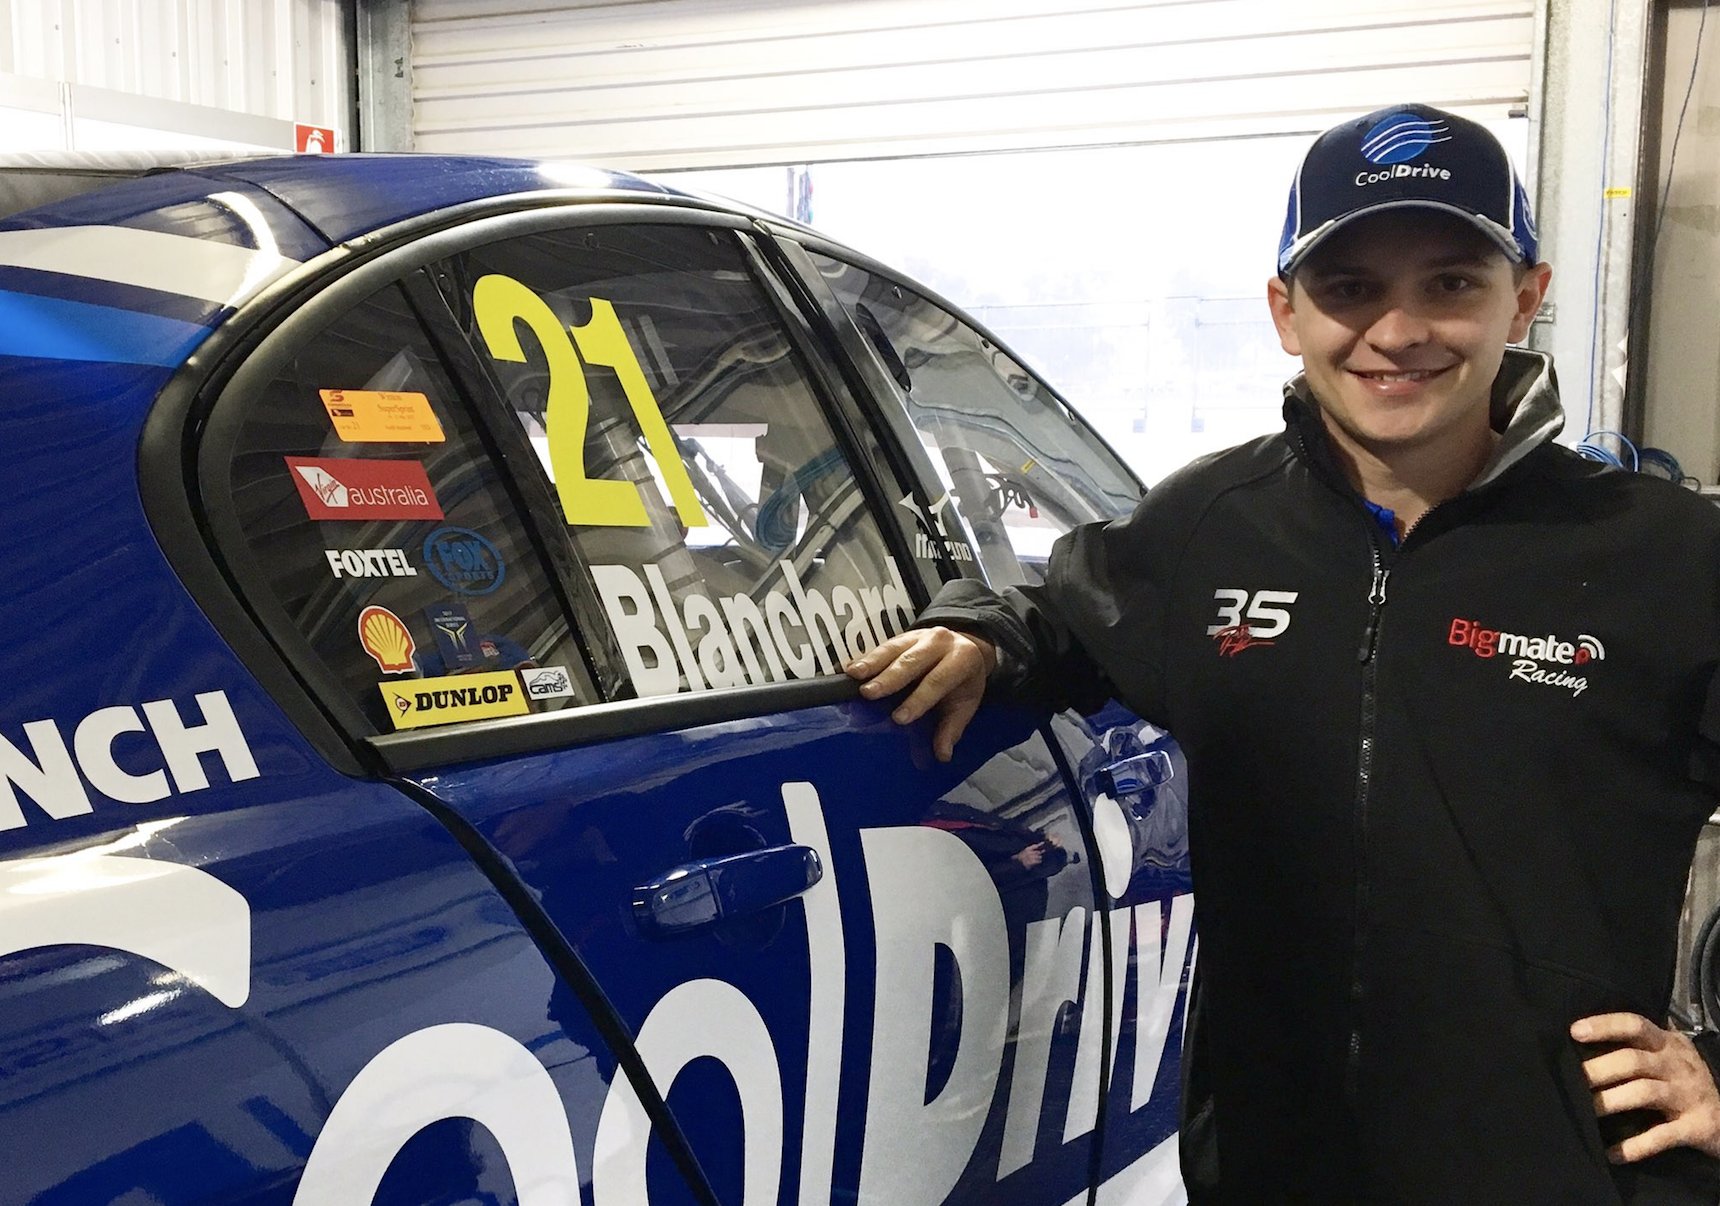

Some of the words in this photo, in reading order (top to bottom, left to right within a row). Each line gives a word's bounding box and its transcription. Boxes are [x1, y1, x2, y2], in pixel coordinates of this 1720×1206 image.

[1356, 163, 1451, 187] CoolDrive
[473, 274, 708, 527] 21
[315, 473, 340, 504] Virgin
[349, 485, 429, 505] australia
[325, 550, 417, 577] FOXTEL
[436, 541, 491, 571] FOX
[589, 554, 917, 698] Blanchard
[1206, 588, 1299, 639] 35
[1449, 618, 1575, 665] Bigmate
[530, 682, 563, 695] cams
[1509, 660, 1589, 697] Racing
[415, 684, 513, 712] DUNLOP
[0, 781, 1199, 1206] oolDriv
